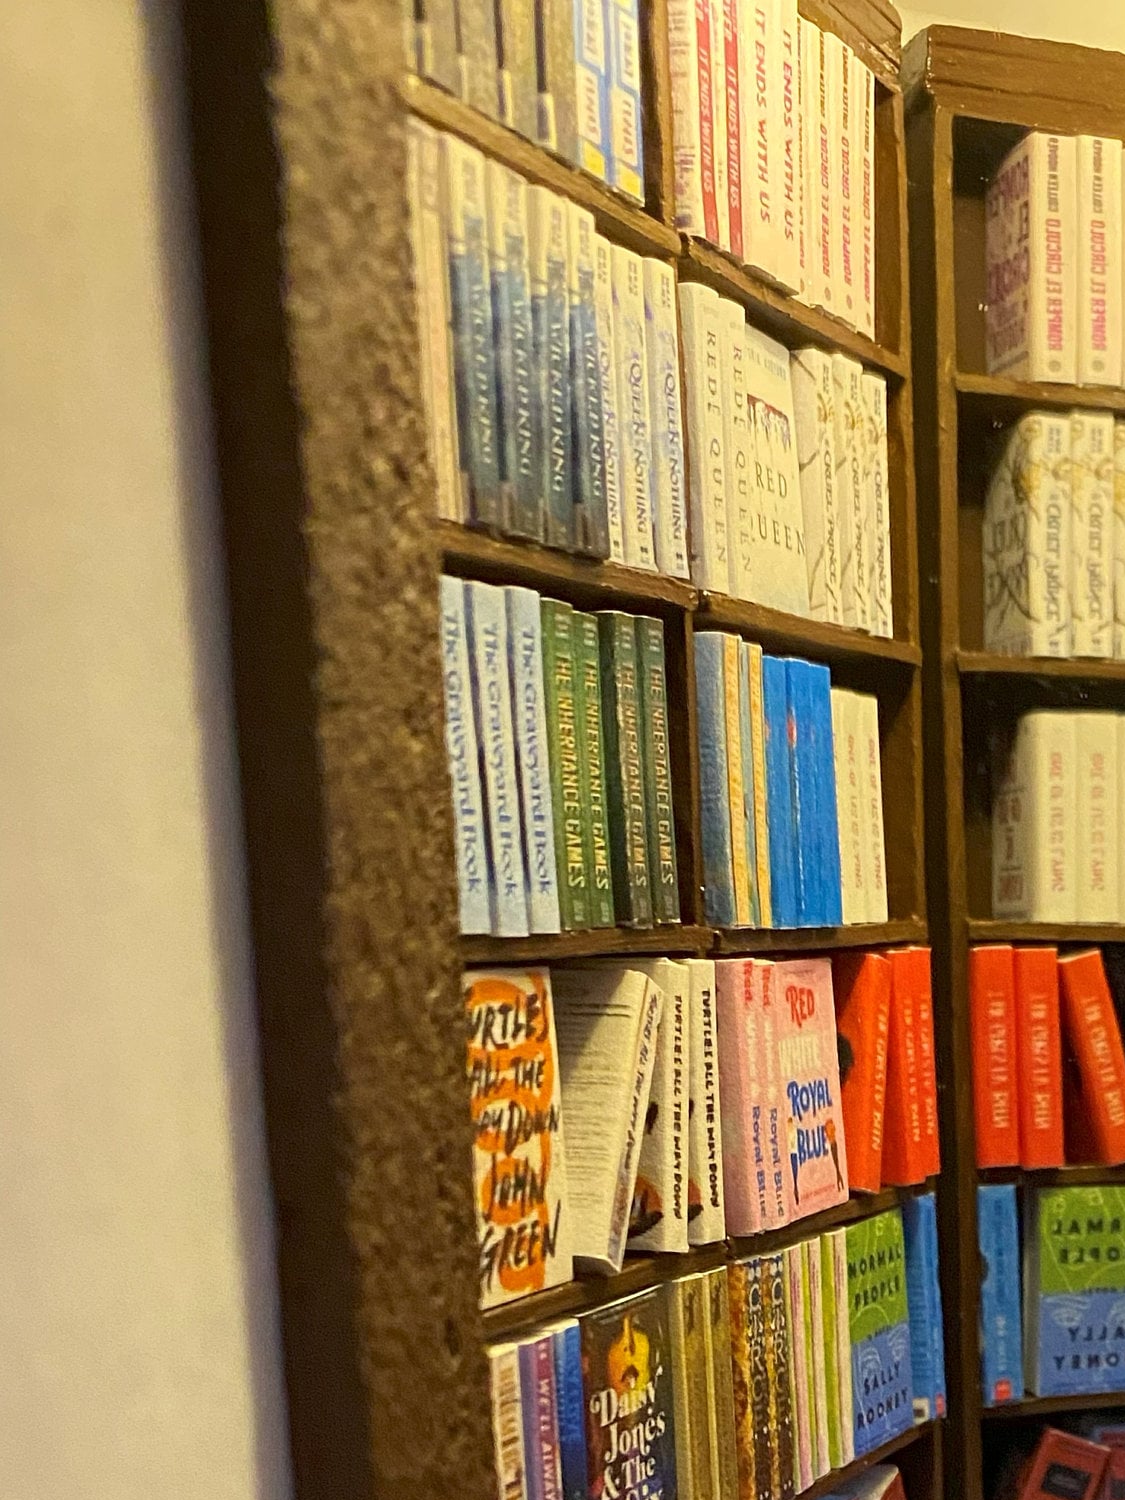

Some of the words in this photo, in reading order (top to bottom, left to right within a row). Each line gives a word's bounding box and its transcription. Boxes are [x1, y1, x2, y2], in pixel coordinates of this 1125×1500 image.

[755, 8, 766, 34] IT
[783, 30, 792, 56] IT
[727, 65, 737, 80] IT
[755, 40, 767, 107] ENDS
[727, 82, 738, 128] ENDS
[783, 61, 793, 128] ENDS
[729, 138, 739, 180] WITH
[758, 119, 769, 182] WITH
[784, 139, 794, 201] WITH
[730, 185, 740, 209] US
[760, 191, 770, 223] US
[784, 210, 794, 242] US
[754, 459, 789, 499] RED
[756, 512, 807, 557] UEEN
[555, 654, 571, 686] THE
[650, 664, 664, 695] THE
[557, 694, 579, 814] INHERITANCE
[651, 704, 670, 814] INHERITANCE
[564, 819, 585, 888] GAMES
[658, 820, 674, 884] GAMES
[468, 988, 548, 1052] URTLES
[702, 987, 714, 1058] TURTLES
[784, 985, 815, 1028] RED
[673, 994, 683, 1063] TURTLES
[512, 1056, 546, 1094] THE
[674, 1068, 683, 1096] ALL
[704, 1062, 716, 1090] ALL
[674, 1103, 682, 1131] THE
[706, 1093, 717, 1123] THE
[786, 1077, 833, 1122] ROYAL
[673, 1136, 682, 1170] WAY
[707, 1127, 717, 1161] WAY
[795, 1124, 831, 1165] BLUE
[673, 1173, 683, 1219] DOWN
[708, 1163, 721, 1208] DOWN
[847, 1249, 903, 1281] NORMAL
[854, 1279, 901, 1308] PEOPLE
[589, 1365, 664, 1428] Daisy
[863, 1363, 903, 1397] SALLY
[856, 1389, 911, 1431] ROONEY
[605, 1410, 666, 1464] Jones
[621, 1455, 656, 1490] The
